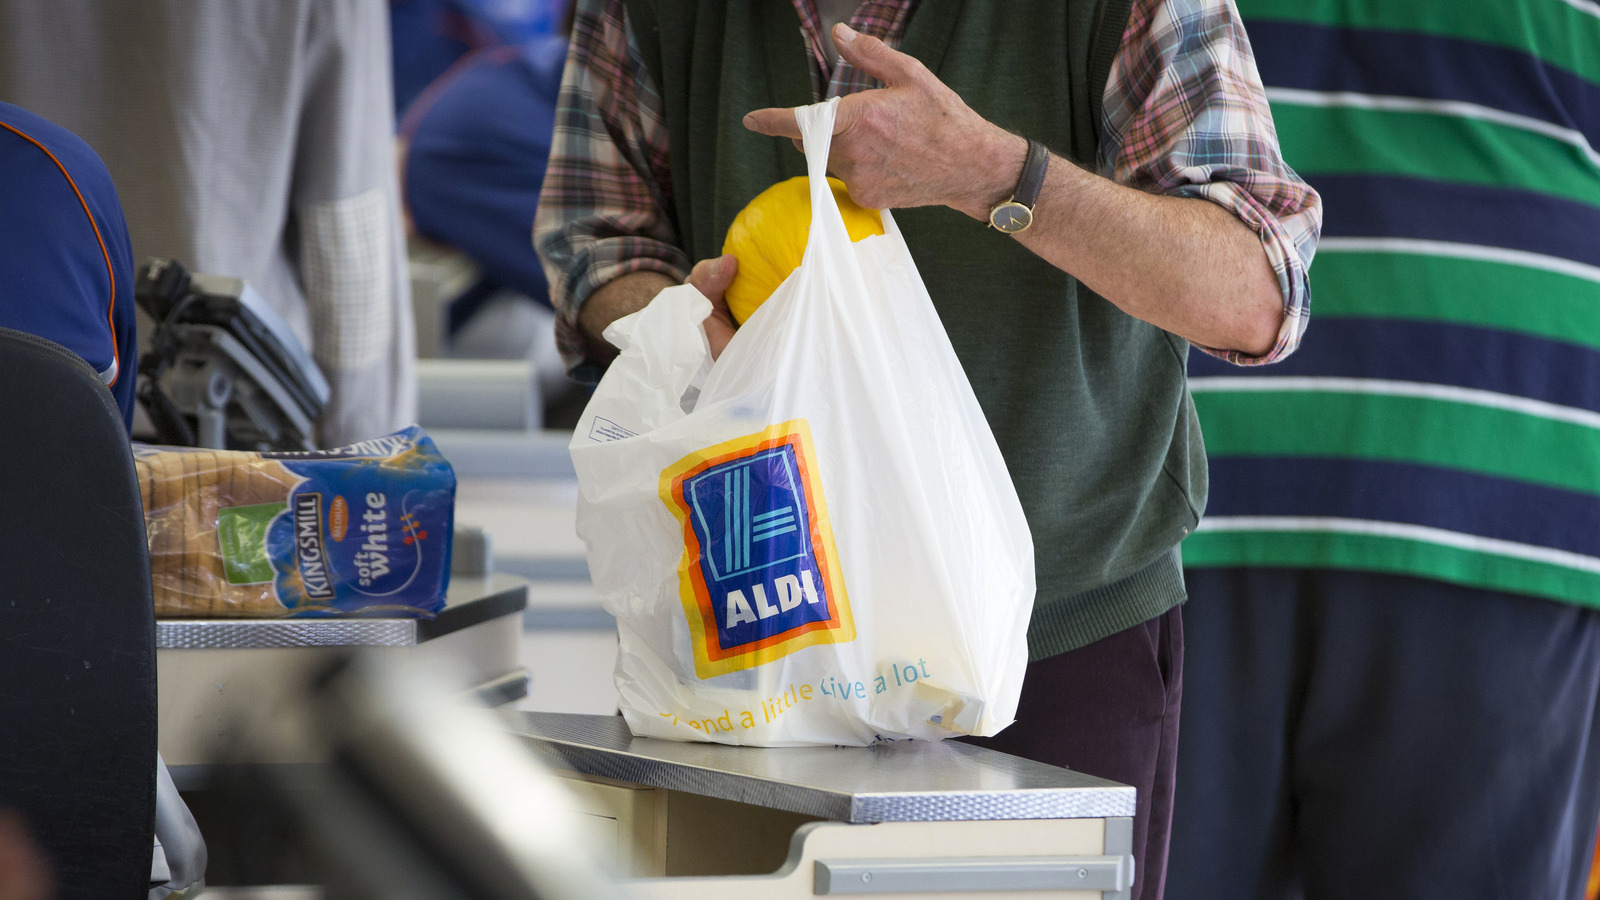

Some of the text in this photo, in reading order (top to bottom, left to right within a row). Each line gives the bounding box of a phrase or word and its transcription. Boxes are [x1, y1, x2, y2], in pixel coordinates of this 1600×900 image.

[298, 498, 331, 596] KINGSMILL
[334, 499, 343, 538] MEDIUM
[360, 492, 390, 579] white
[353, 552, 371, 587] soft
[726, 569, 819, 629] ALDI
[660, 708, 734, 735] end
[740, 710, 755, 729] a
[761, 683, 813, 724] little
[873, 675, 887, 695] a
[892, 658, 930, 687] lot
